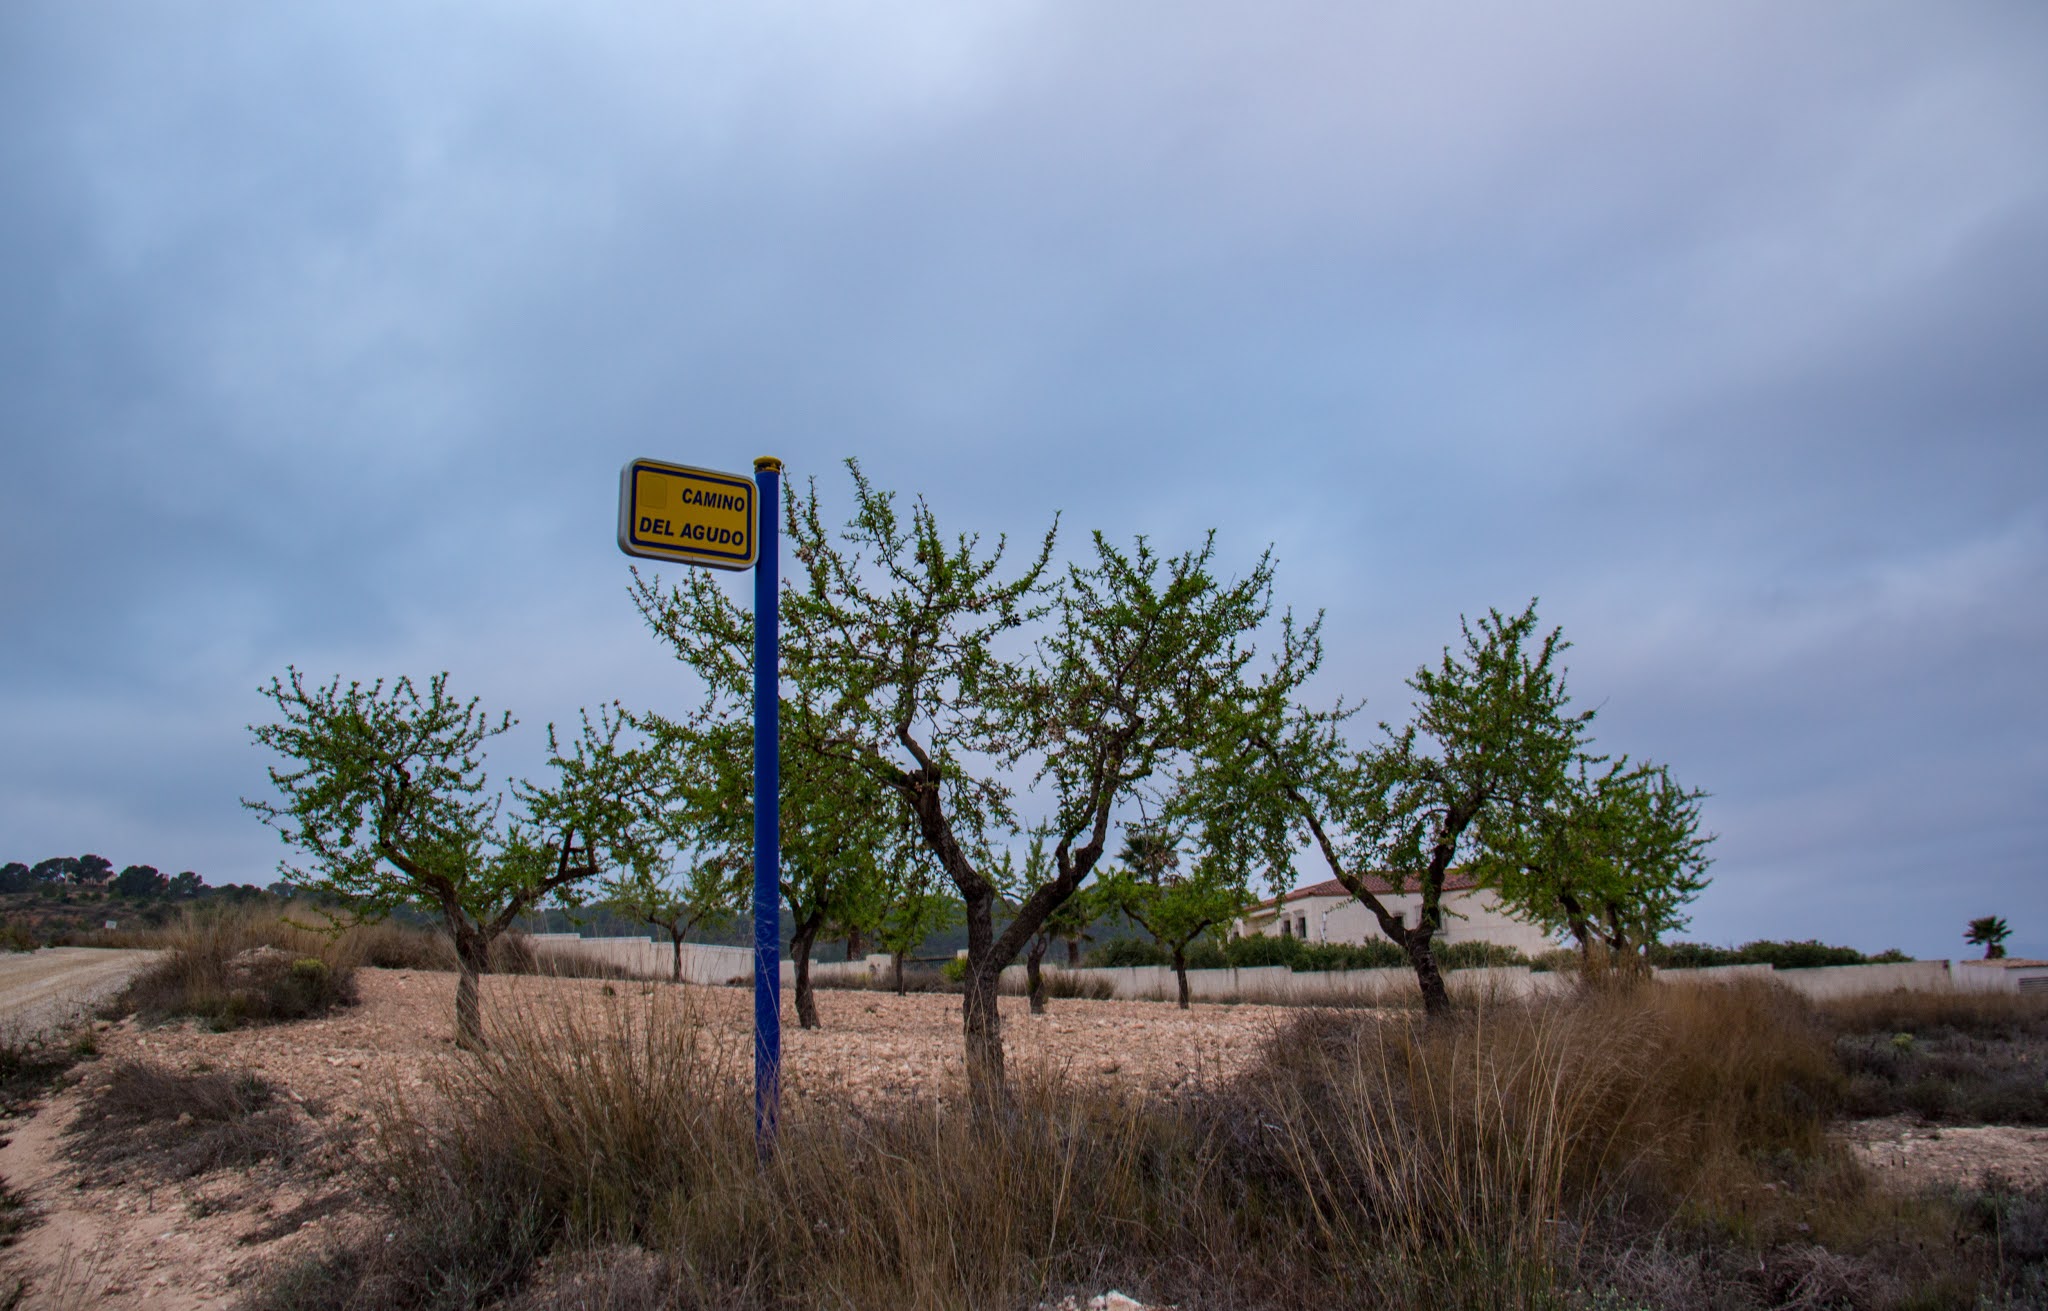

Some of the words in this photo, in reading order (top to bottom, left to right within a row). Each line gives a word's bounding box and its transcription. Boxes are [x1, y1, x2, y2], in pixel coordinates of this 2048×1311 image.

[682, 488, 745, 512] CAMINO
[639, 517, 674, 536] DEL
[680, 523, 744, 546] AGUDO
